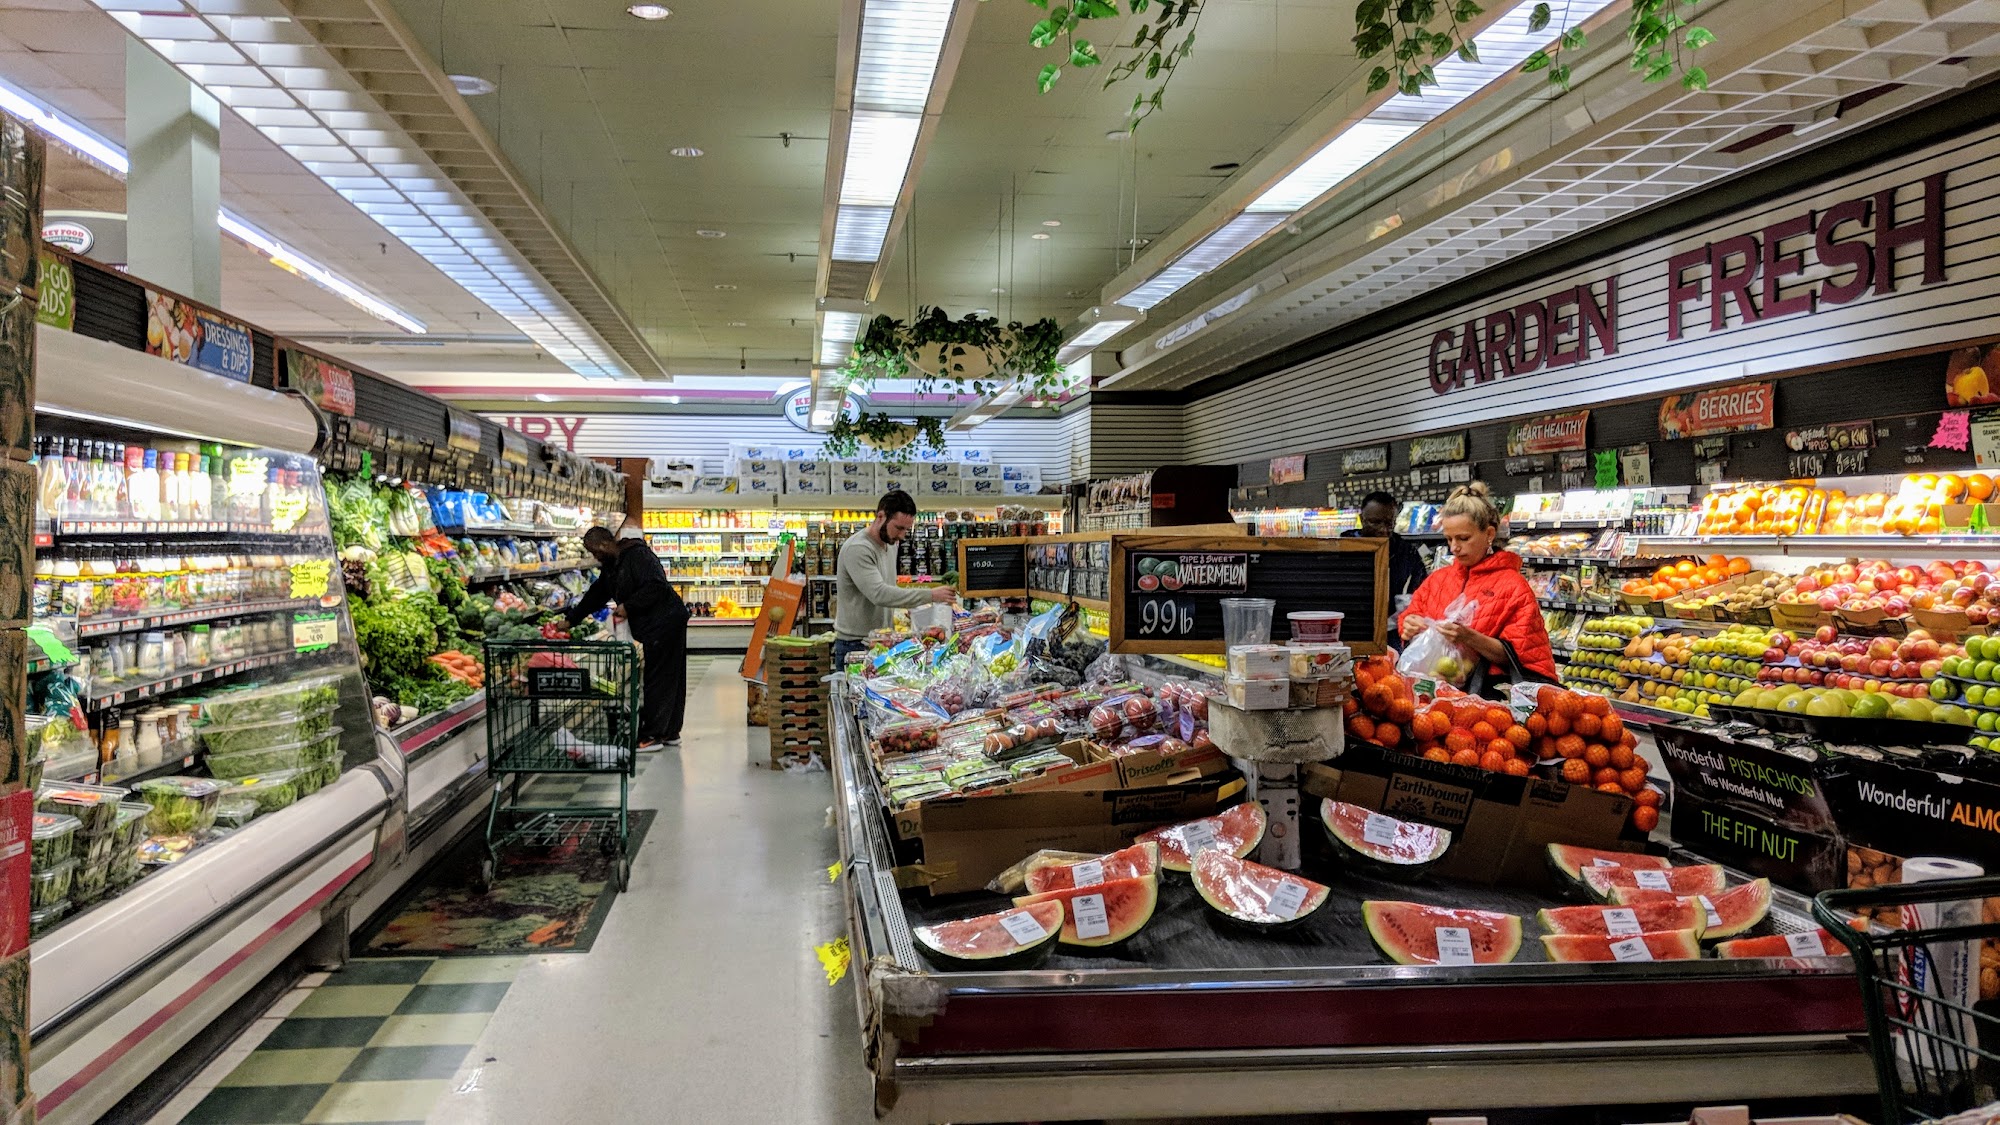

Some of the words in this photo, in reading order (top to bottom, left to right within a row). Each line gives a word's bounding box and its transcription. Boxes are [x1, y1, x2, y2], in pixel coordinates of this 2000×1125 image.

[61, 229, 84, 238] FOOD
[1429, 275, 1619, 395] GARDEN
[1666, 171, 1949, 342] FRESH
[204, 321, 249, 356] DRESSINGS
[221, 348, 229, 369] &
[230, 351, 249, 375] DIPS
[1700, 388, 1765, 421] BERRIES
[1516, 424, 1543, 442] HEART
[1543, 418, 1584, 439] HEALTHY
[1174, 563, 1247, 587] WATERMELON
[1179, 555, 1199, 564] RIPE
[1206, 555, 1235, 564] SWEET
[1139, 599, 1177, 635] .99
[1180, 607, 1194, 635] lb
[1382, 749, 1416, 767] Farm
[1417, 758, 1456, 777] Fresh
[1661, 739, 1726, 772] Wonderful
[1728, 755, 1816, 799] PISTACHIOS
[1393, 776, 1470, 805] Earthbound
[1700, 771, 1718, 788] The
[1718, 775, 1765, 803] Wonderful
[1766, 791, 1785, 810] Nut
[1857, 779, 1947, 821] Wonderful
[1431, 799, 1464, 821] Farm
[1702, 809, 1730, 842] THE
[1733, 820, 1757, 849] FIT
[1761, 830, 1799, 863] NUT
